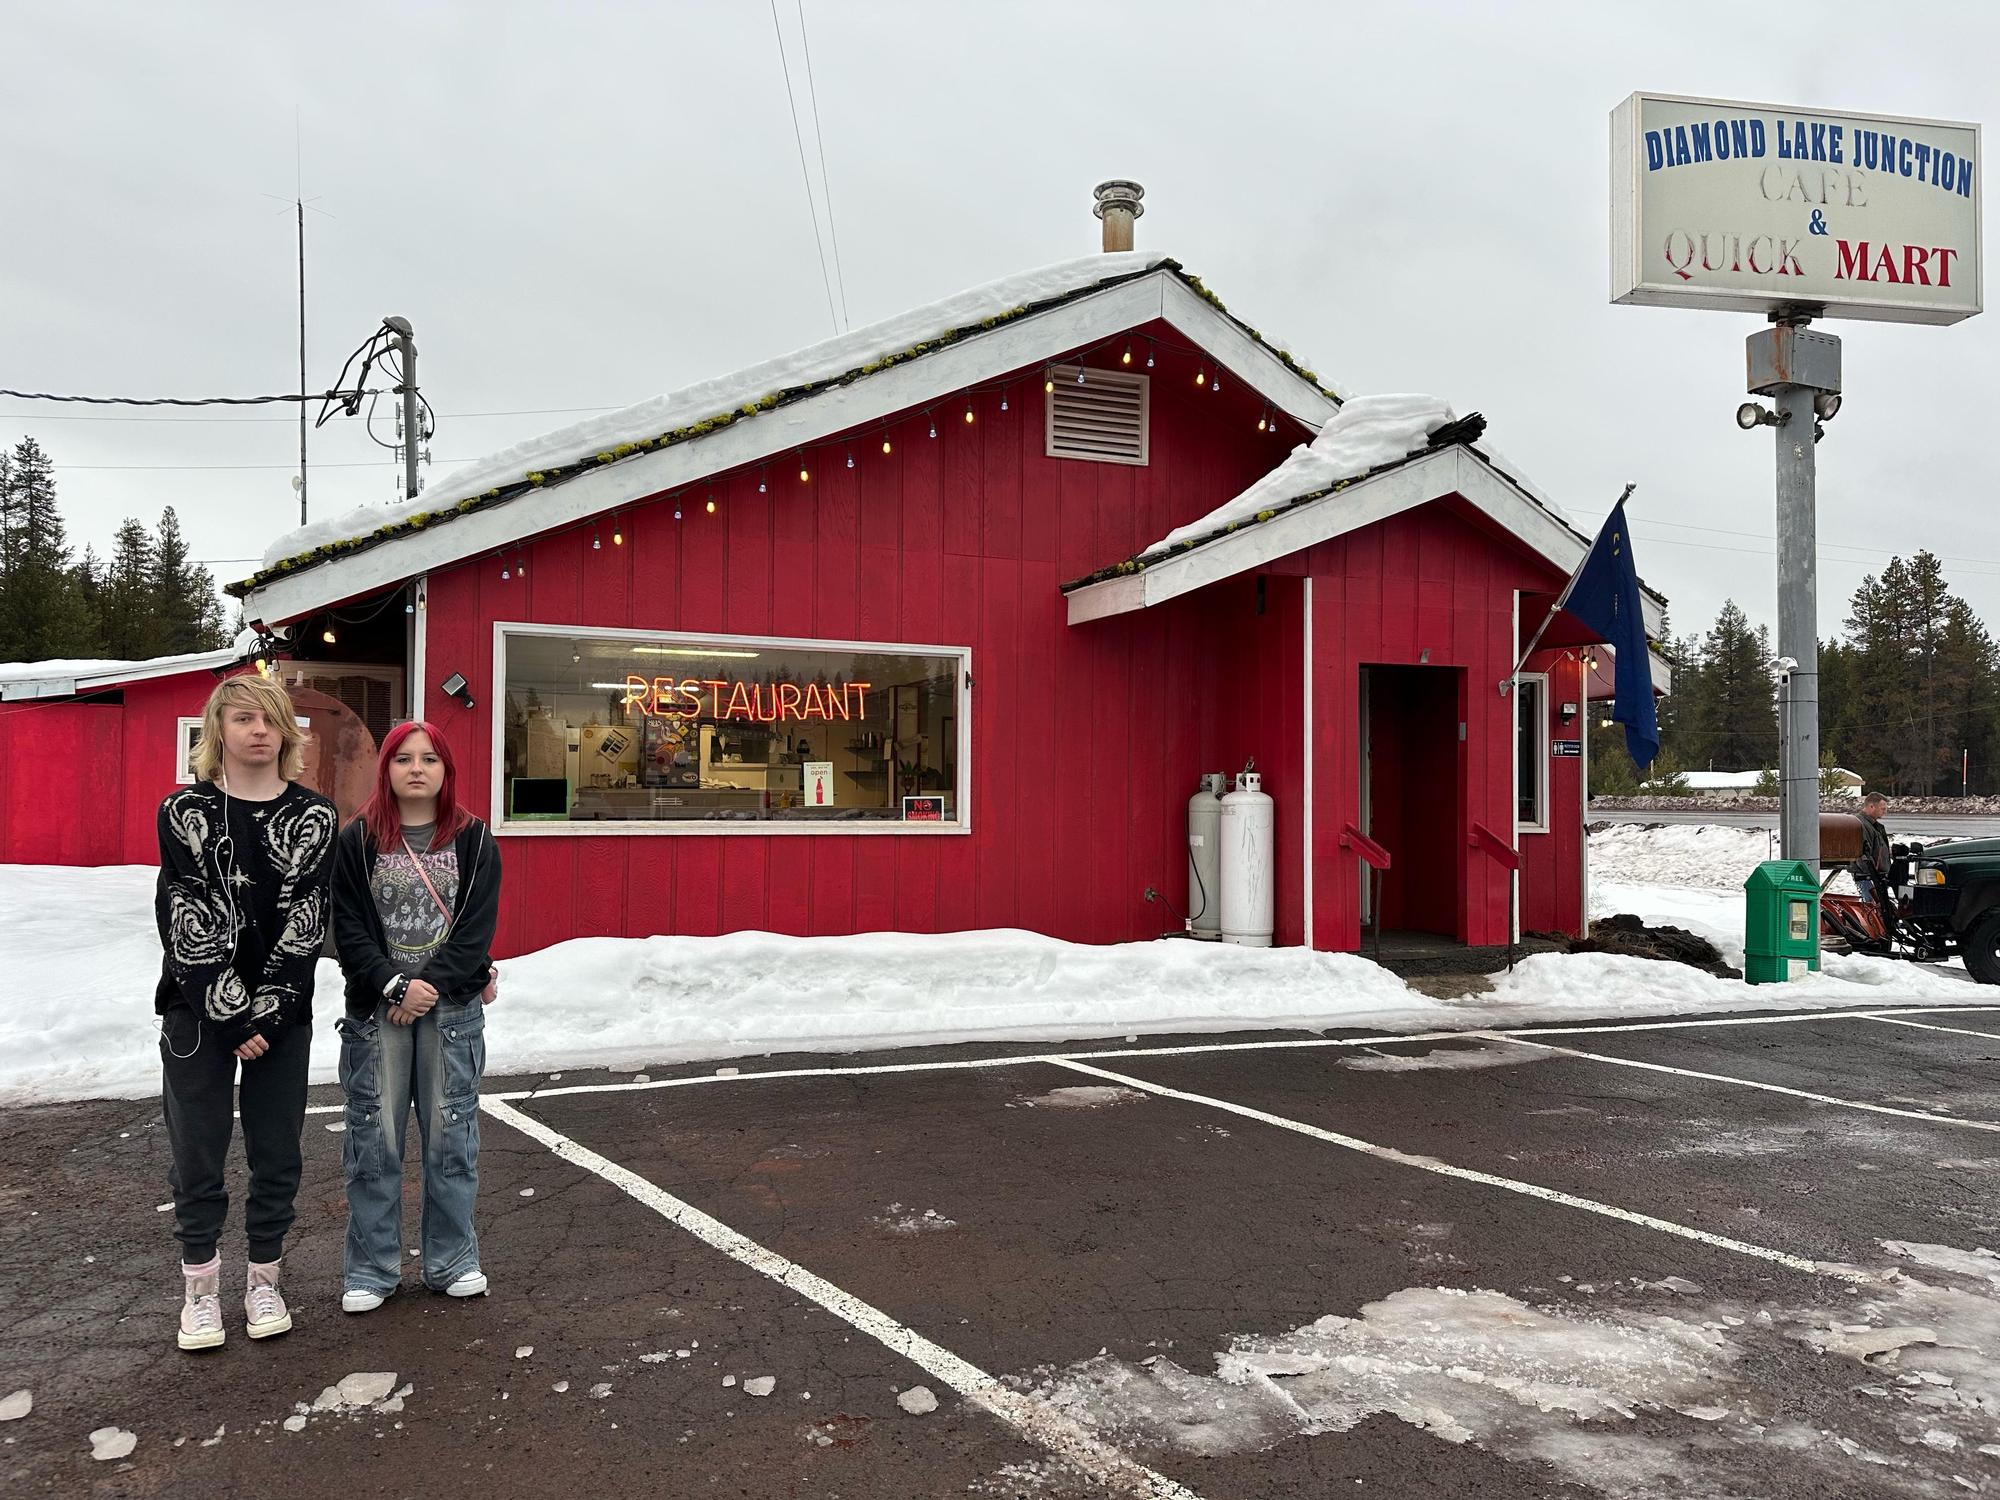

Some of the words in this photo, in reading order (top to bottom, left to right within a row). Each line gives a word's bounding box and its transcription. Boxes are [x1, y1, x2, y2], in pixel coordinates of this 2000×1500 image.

[1644, 119, 1767, 172] DIAMOND
[1777, 120, 1843, 164] LAKE
[1853, 129, 1973, 198] JUNCTION
[1759, 164, 1868, 207] CAFE
[1808, 208, 1829, 236] &
[1663, 228, 1806, 281] QUICK
[1834, 239, 1958, 287] MART
[626, 675, 872, 721] RESTAURANT
[913, 800, 933, 810] NO
